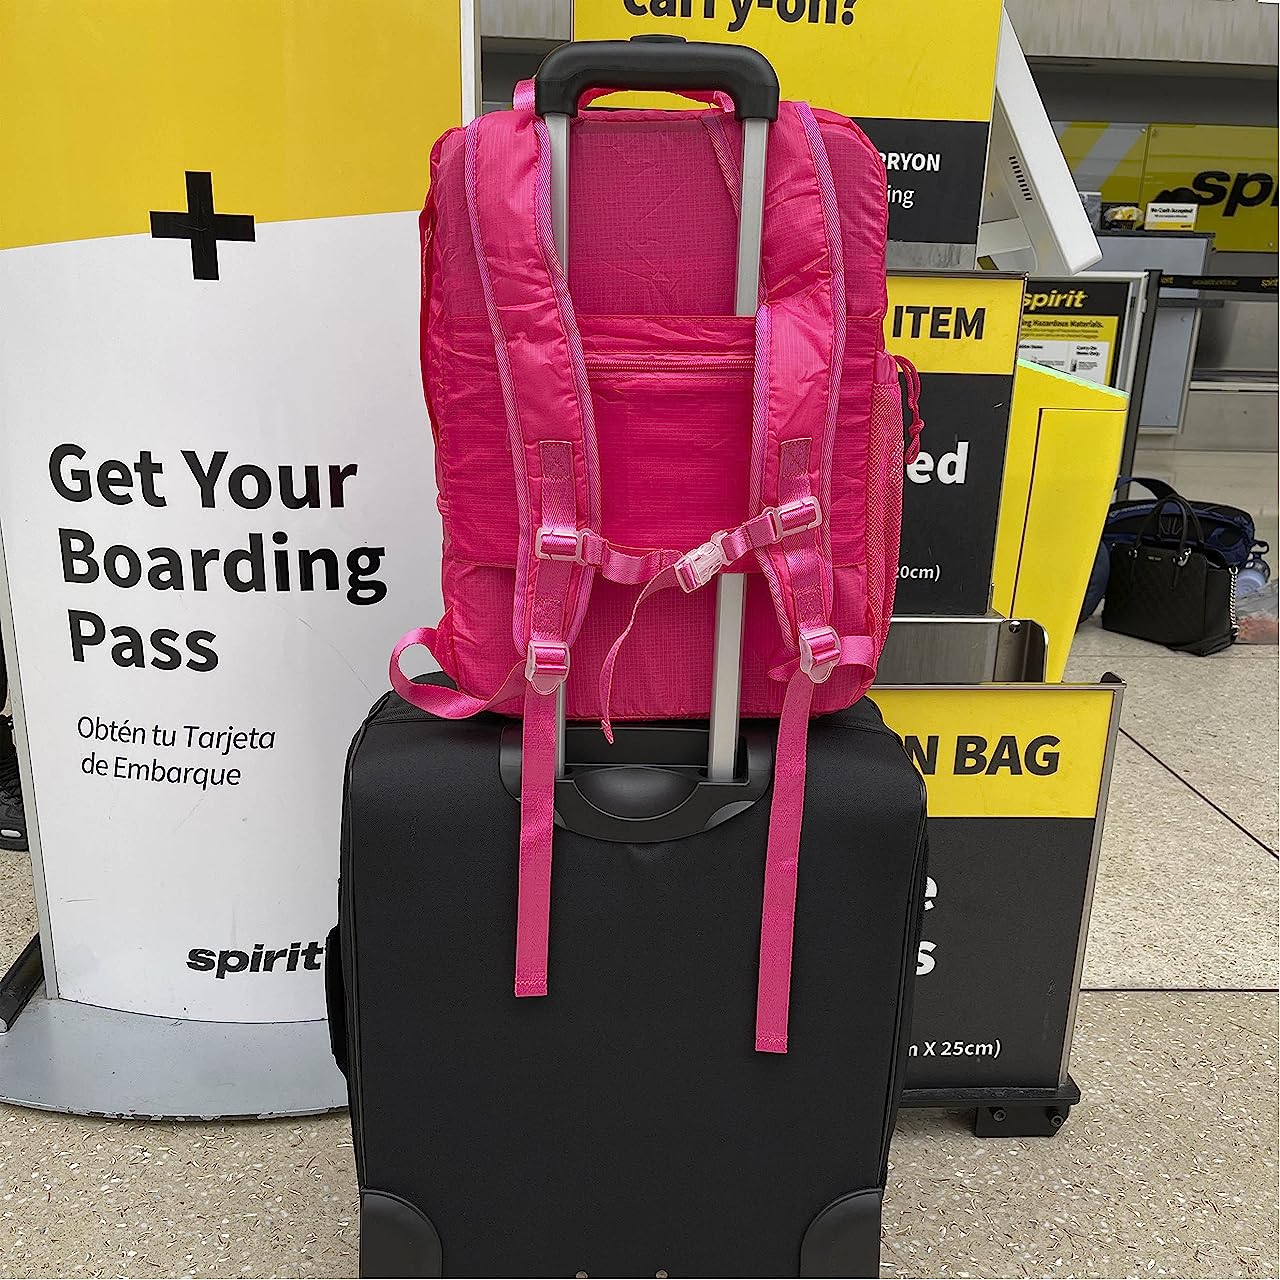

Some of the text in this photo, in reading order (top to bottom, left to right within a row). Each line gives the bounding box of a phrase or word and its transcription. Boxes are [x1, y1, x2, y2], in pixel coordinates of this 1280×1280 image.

[892, 304, 986, 341] ITEM
[49, 443, 358, 510] Get Your
[58, 528, 387, 606] Boarding
[67, 608, 220, 672] Pass
[77, 716, 276, 757] Obtén tu Tarjeta
[953, 735, 1061, 776] BAG
[81, 753, 241, 788] de Embarque
[185, 942, 325, 980] spirit
[922, 1041, 937, 1057] X
[940, 1039, 1001, 1059] 25cm)
